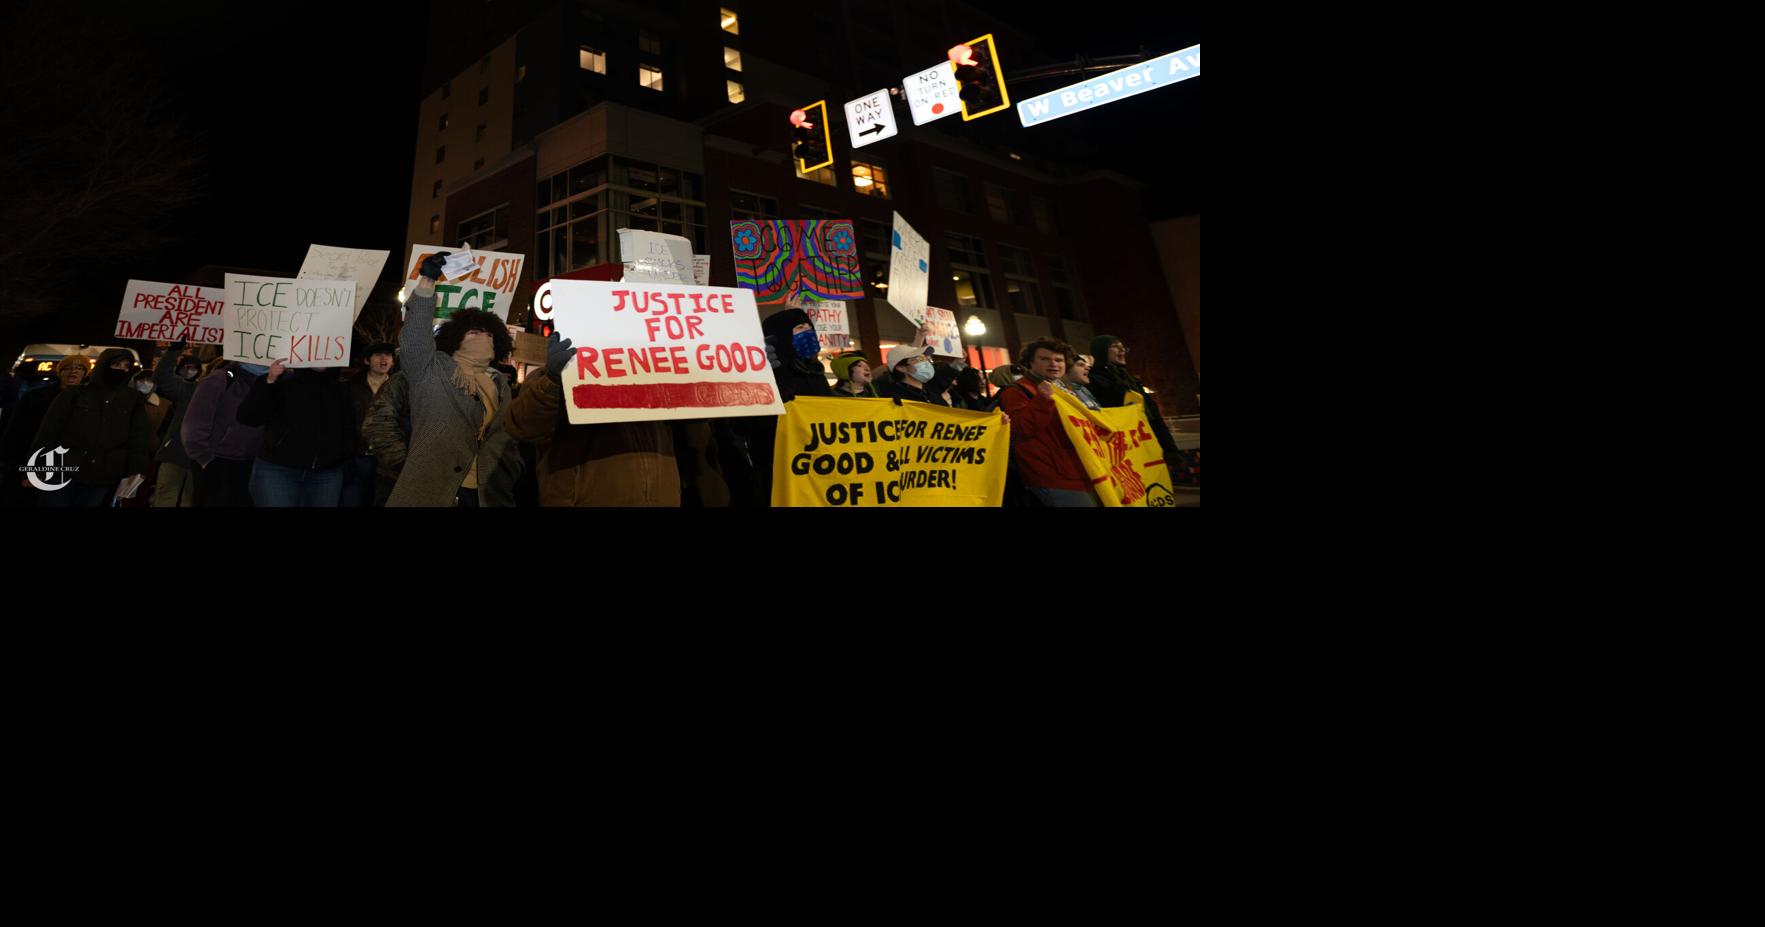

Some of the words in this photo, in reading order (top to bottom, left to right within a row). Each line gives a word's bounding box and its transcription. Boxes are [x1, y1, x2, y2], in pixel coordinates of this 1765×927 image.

[918, 80, 946, 95] TURN
[919, 70, 939, 84] NO
[854, 96, 881, 114] ONE
[914, 98, 929, 108] ON
[934, 87, 956, 100] RED
[1027, 98, 1050, 117] W
[1060, 67, 1153, 108] Beaver
[855, 108, 882, 126] WAY
[761, 224, 837, 252] COME
[409, 253, 521, 294] ALISH
[735, 254, 863, 296] TOGETHER
[168, 285, 206, 300] ALL
[233, 280, 293, 308] ICE
[611, 289, 735, 316] JUSTICE
[159, 310, 204, 327] ARE
[236, 308, 320, 332] PROTECT
[644, 315, 704, 342] FOR
[807, 308, 841, 322] PATHY
[233, 330, 282, 360] ICE
[290, 334, 345, 364] KILLS
[576, 346, 690, 380] RENEE
[696, 342, 766, 373] GOOD
[804, 419, 900, 452] JUSTICE
[900, 419, 928, 438] FOR
[930, 421, 987, 442] RENEE
[791, 451, 874, 475] GOOD
[886, 450, 900, 472] &
[900, 445, 909, 466] LL
[916, 446, 986, 465] VICTIMS
[825, 482, 864, 506] OF
[875, 480, 900, 504] IC
[900, 469, 957, 491] URDER!
